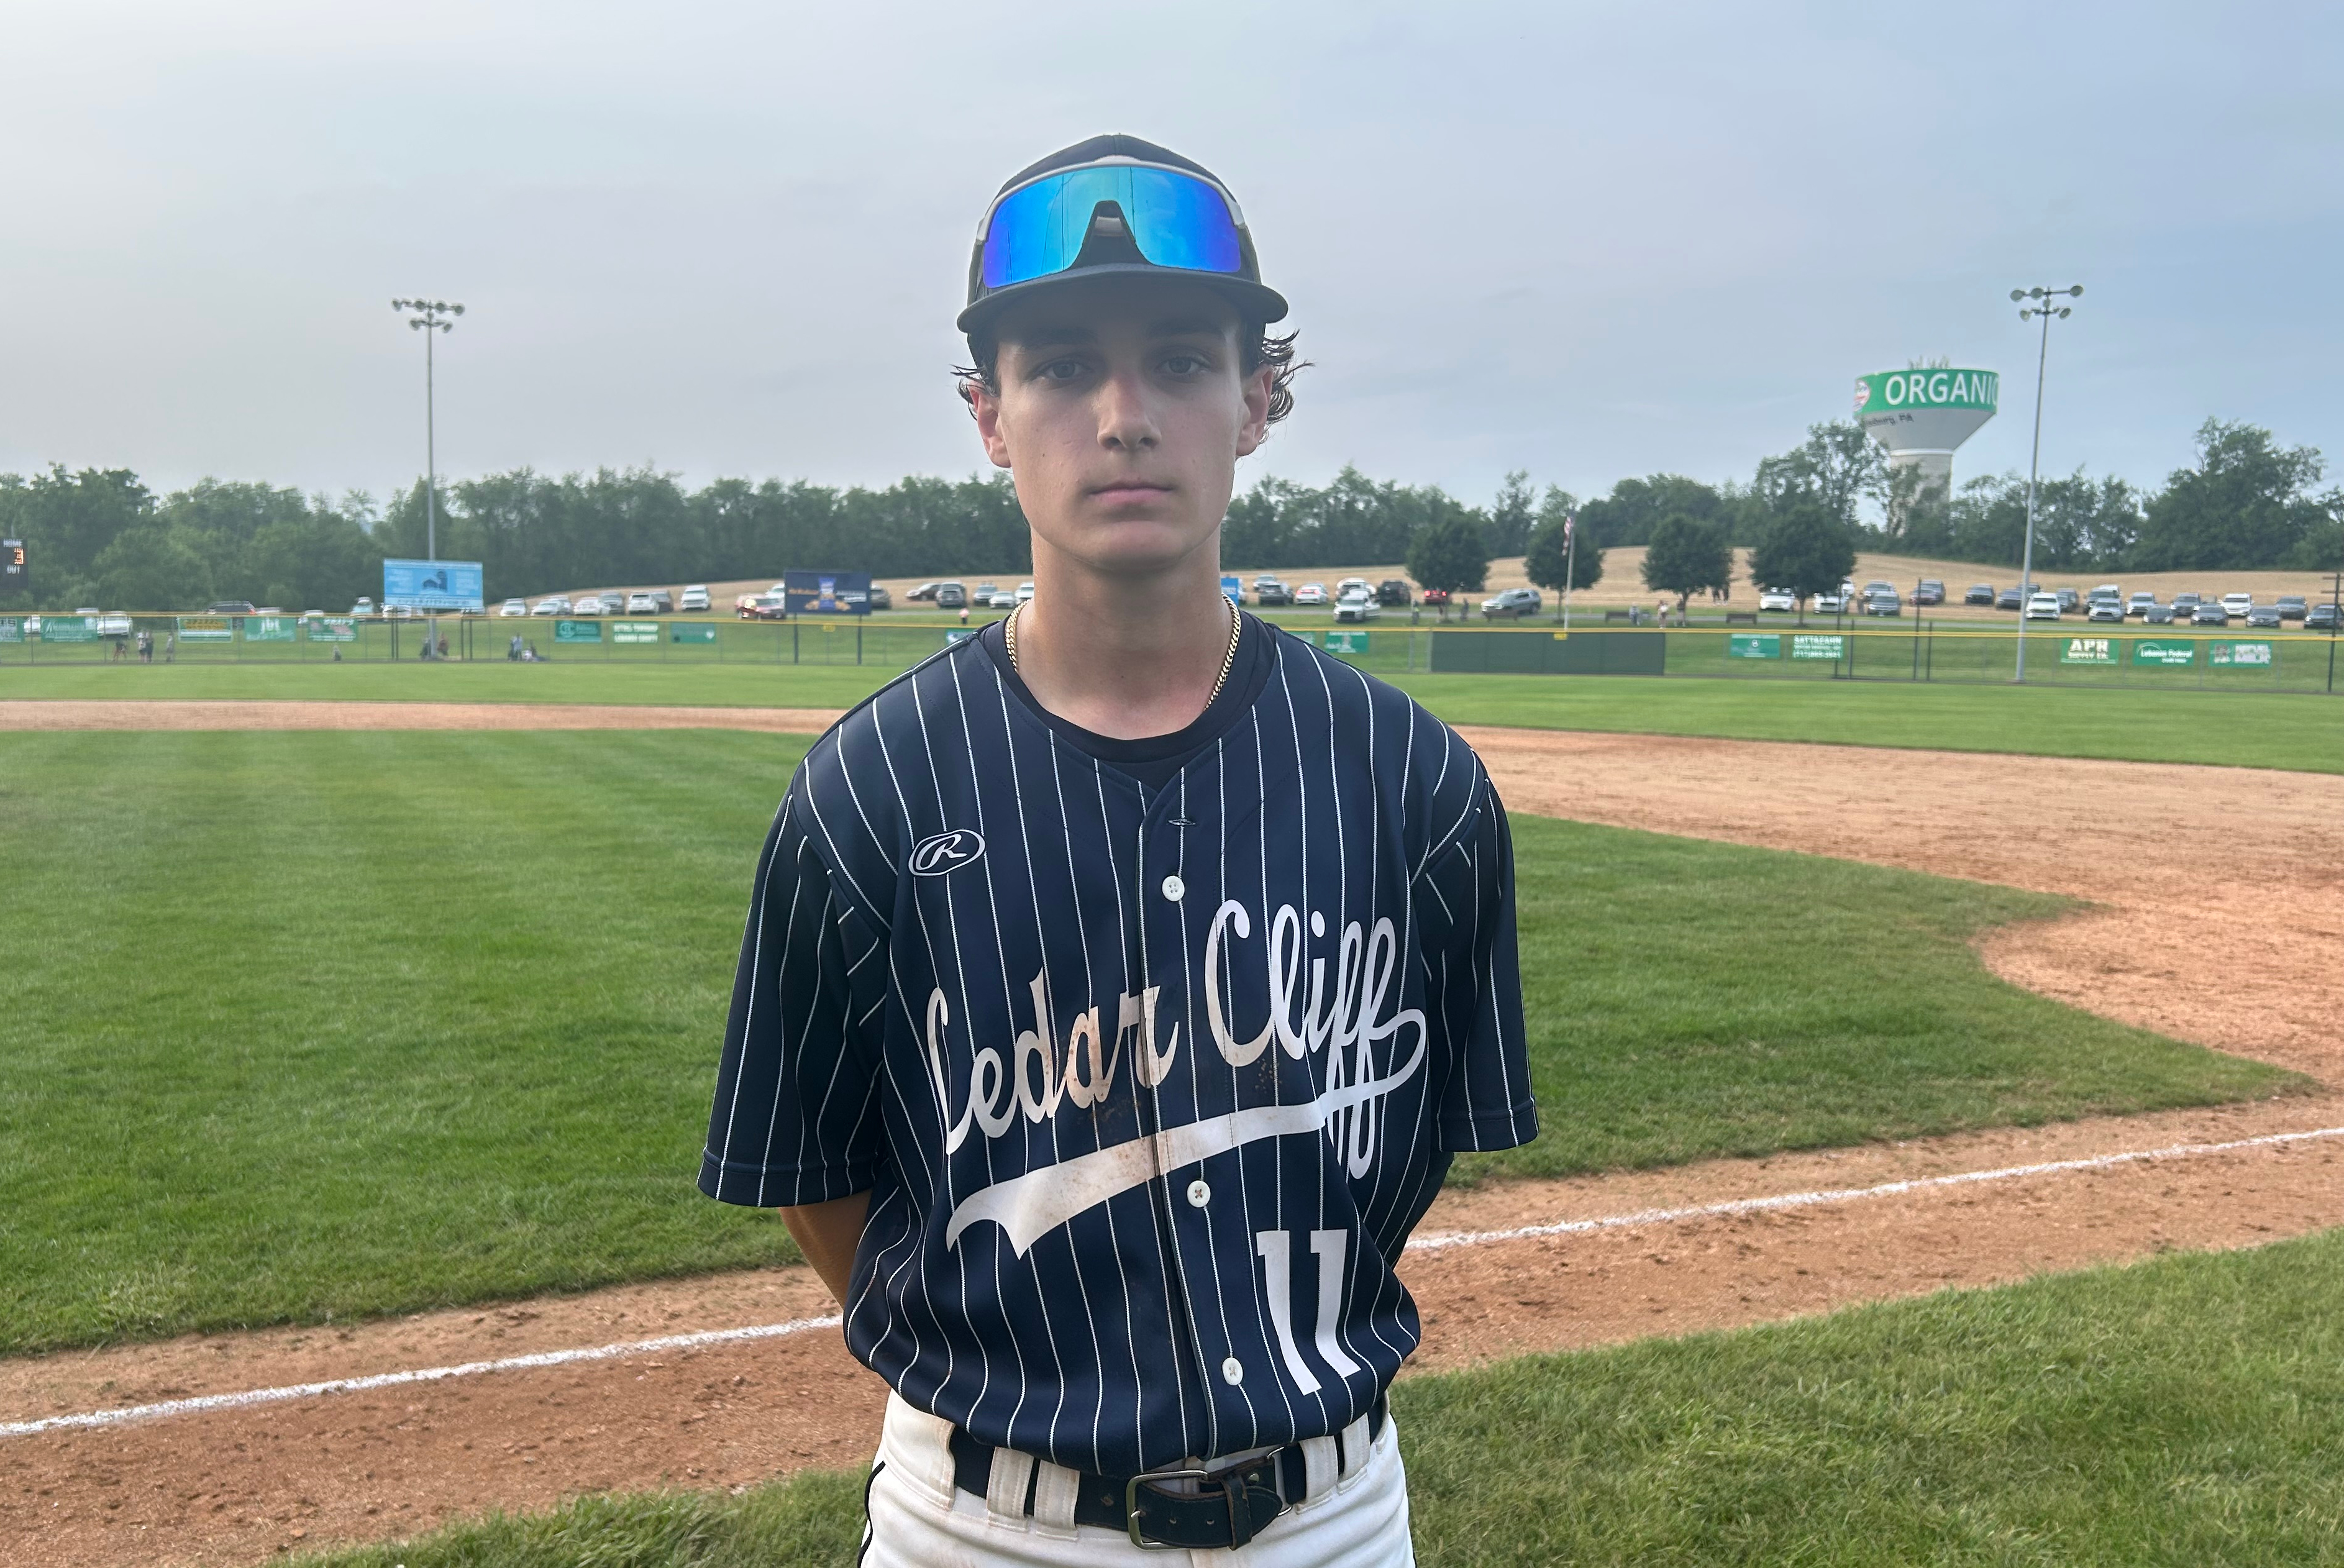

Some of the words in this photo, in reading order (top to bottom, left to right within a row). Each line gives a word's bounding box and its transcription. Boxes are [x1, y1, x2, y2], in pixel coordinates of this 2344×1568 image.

[3, 539, 23, 548] HOME
[14, 548, 24, 565] 3
[7, 565, 21, 575] OUT
[2069, 638, 2108, 652] APR
[2141, 649, 2167, 657] Lebanon
[2168, 649, 2192, 659] Federal
[926, 967, 1179, 1155] Cedar
[1204, 899, 1426, 1180] Cliff
[1256, 1228, 1361, 1395] 11
